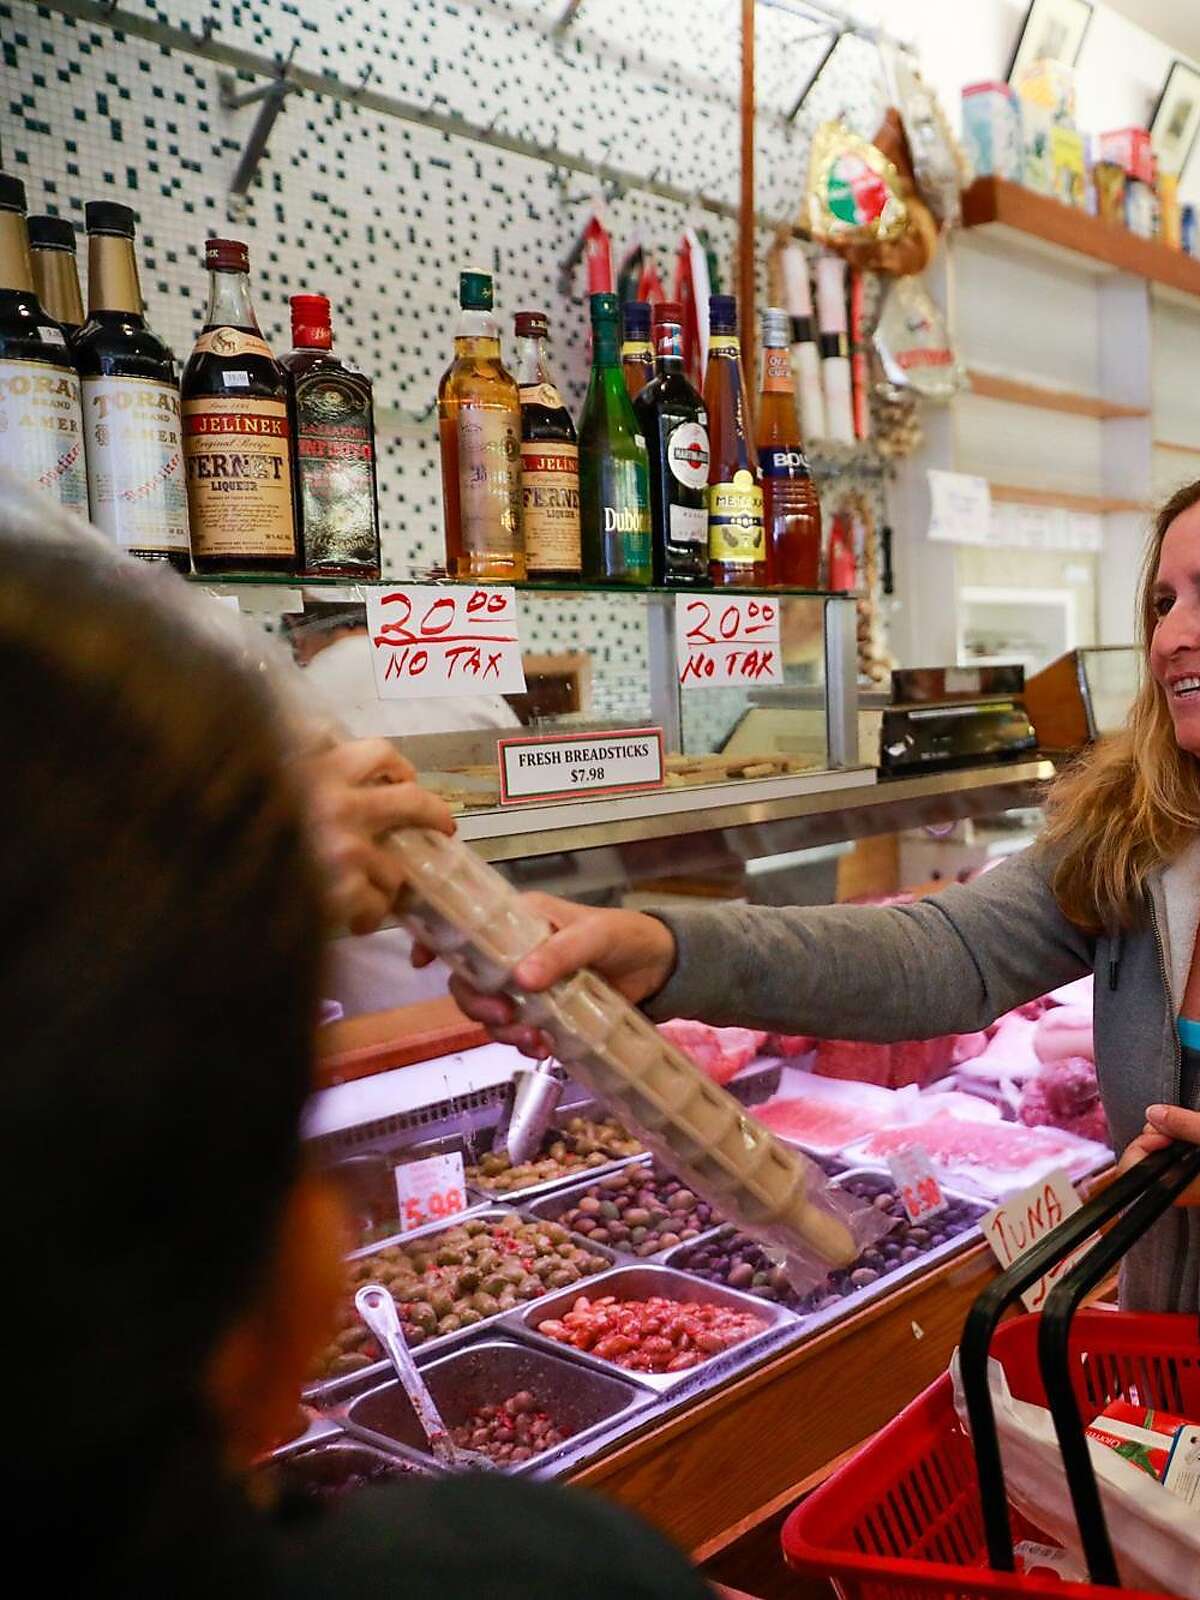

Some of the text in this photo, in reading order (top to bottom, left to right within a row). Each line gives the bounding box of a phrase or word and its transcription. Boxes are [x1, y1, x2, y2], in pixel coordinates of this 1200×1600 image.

[0, 375, 77, 400] ORA
[199, 414, 283, 435] JELÍNEK
[385, 646, 502, 682] NO TAX
[680, 649, 775, 684] NO TAX
[518, 743, 650, 768] FRESH BREADSTICKS
[570, 767, 606, 783] $7.98
[991, 1183, 1063, 1263] TUNA
